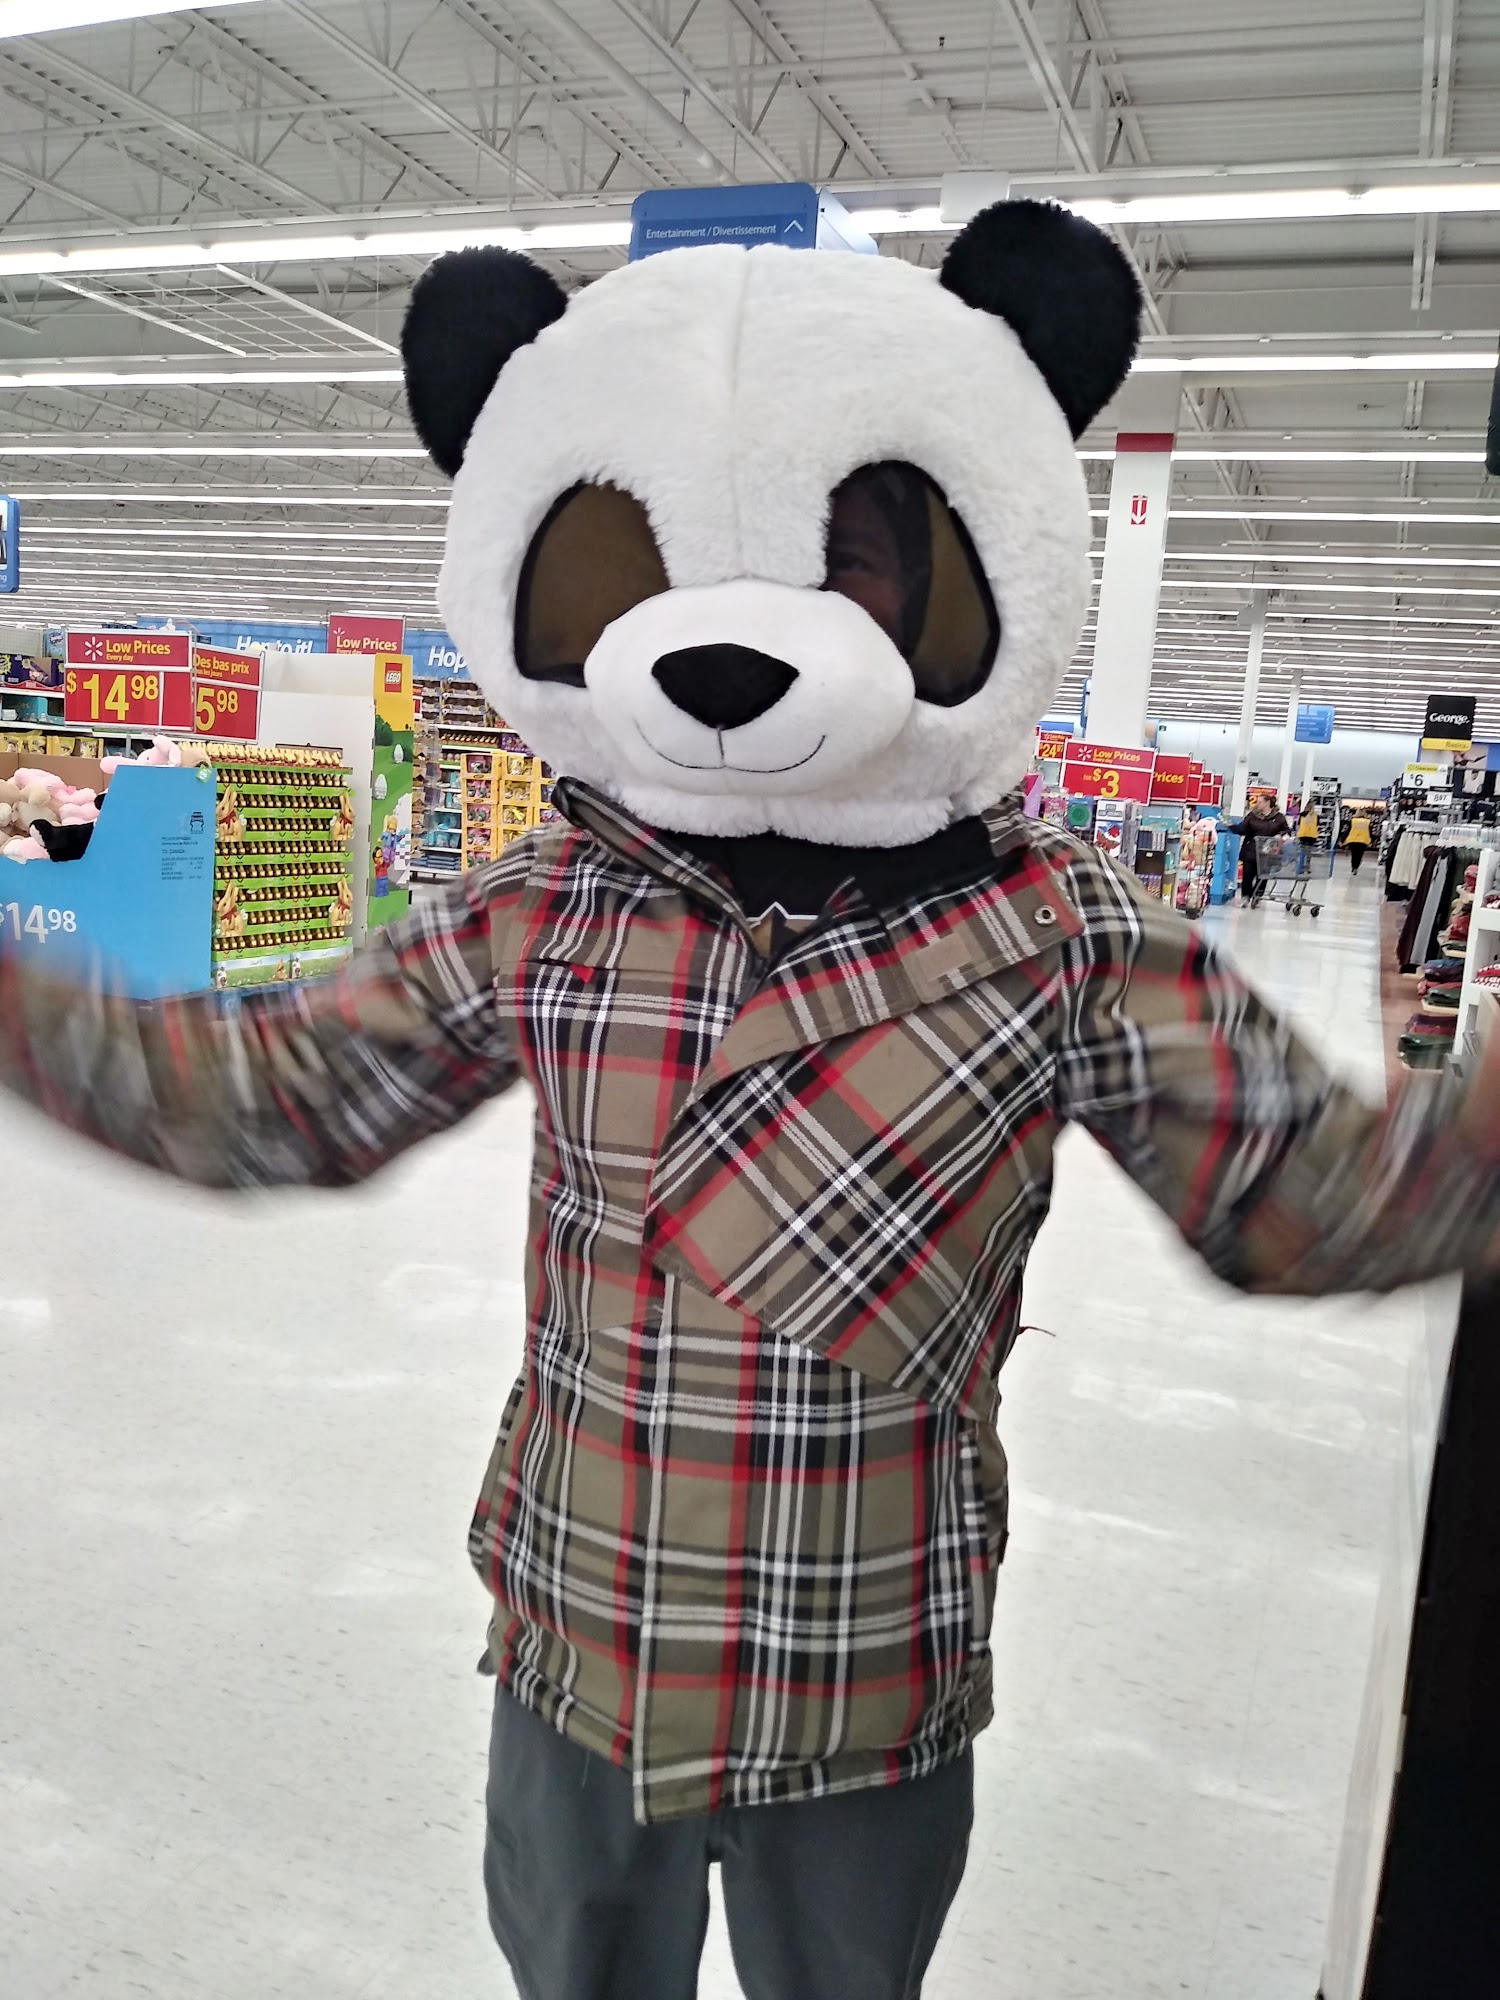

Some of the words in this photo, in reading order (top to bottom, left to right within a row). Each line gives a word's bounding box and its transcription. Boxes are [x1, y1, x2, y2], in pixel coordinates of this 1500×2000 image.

[645, 228, 706, 239] Entertainment
[712, 225, 777, 236] Divertissement
[105, 639, 132, 653] Low
[133, 639, 171, 655] Prices
[336, 636, 361, 649] Low
[362, 637, 398, 652] Prices
[106, 653, 122, 662] Every
[122, 654, 134, 663] day
[192, 653, 211, 669] Des
[212, 656, 230, 672] bas
[231, 661, 250, 675] prix
[385, 670, 401, 685] LEGO
[1093, 749, 1113, 759] Low
[1113, 751, 1141, 762] Prices
